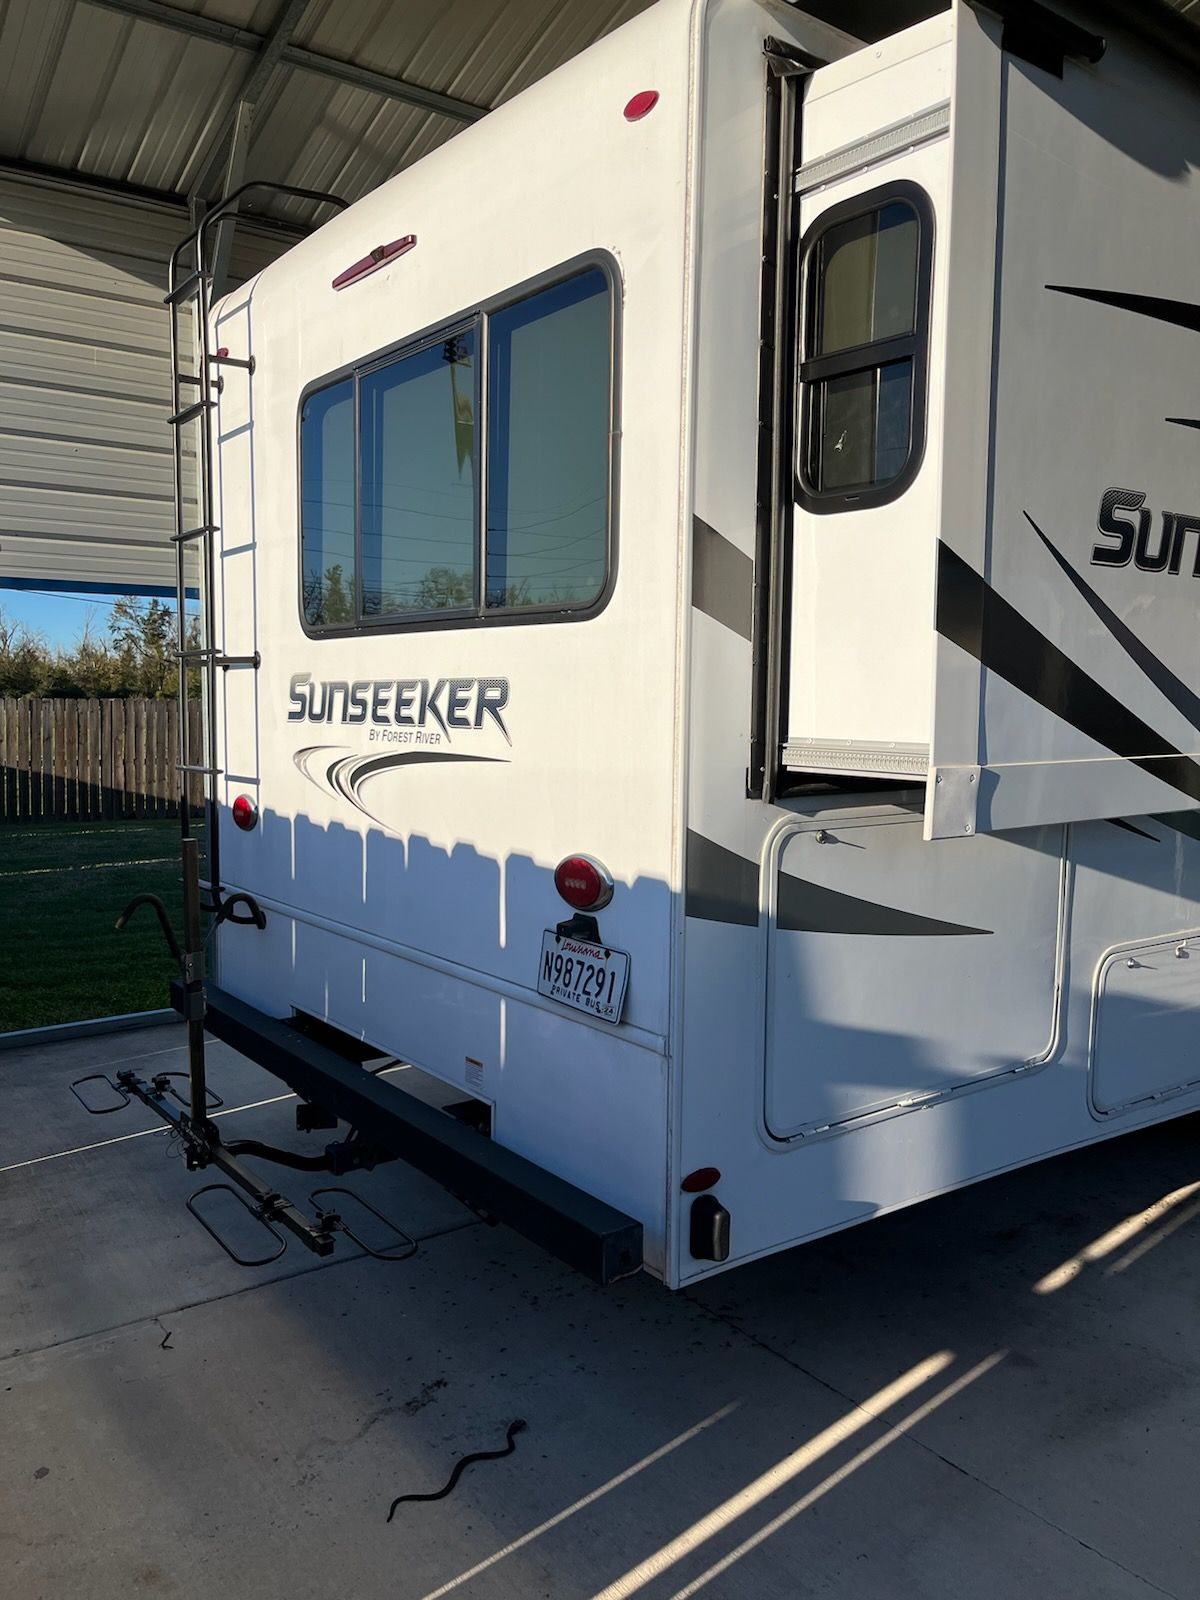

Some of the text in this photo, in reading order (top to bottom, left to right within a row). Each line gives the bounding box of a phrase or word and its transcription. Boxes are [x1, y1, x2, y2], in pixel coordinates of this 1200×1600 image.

[382, 729, 413, 744] FOREST
[414, 731, 441, 745] RIVER
[543, 951, 616, 1003] N987291
[550, 985, 601, 1010] PRIVATE BUS
